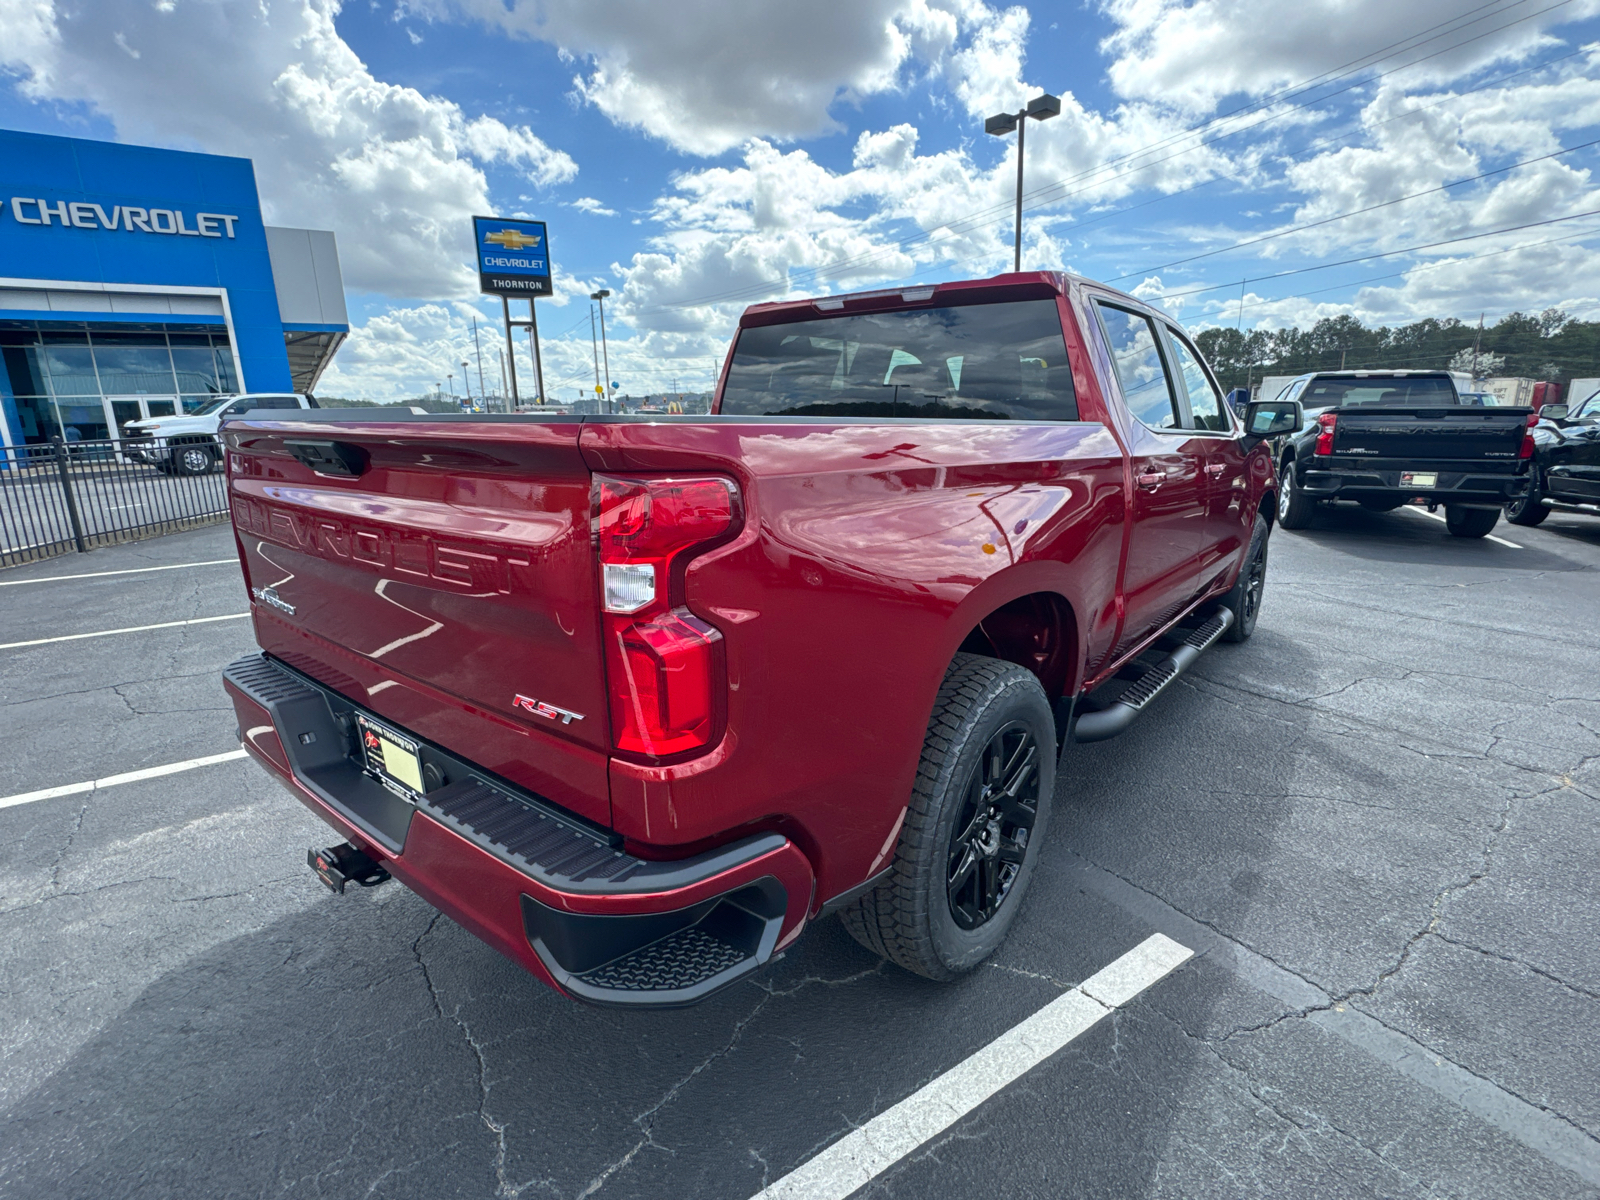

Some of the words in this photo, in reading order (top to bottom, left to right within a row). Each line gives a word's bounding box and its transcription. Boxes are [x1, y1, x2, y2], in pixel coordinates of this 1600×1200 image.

[11, 196, 239, 239] CHEVROLET
[484, 256, 544, 269] CHEVROLET
[492, 279, 543, 290] THORNTON
[232, 496, 530, 596] CHEVROLET
[512, 693, 586, 725] RST
